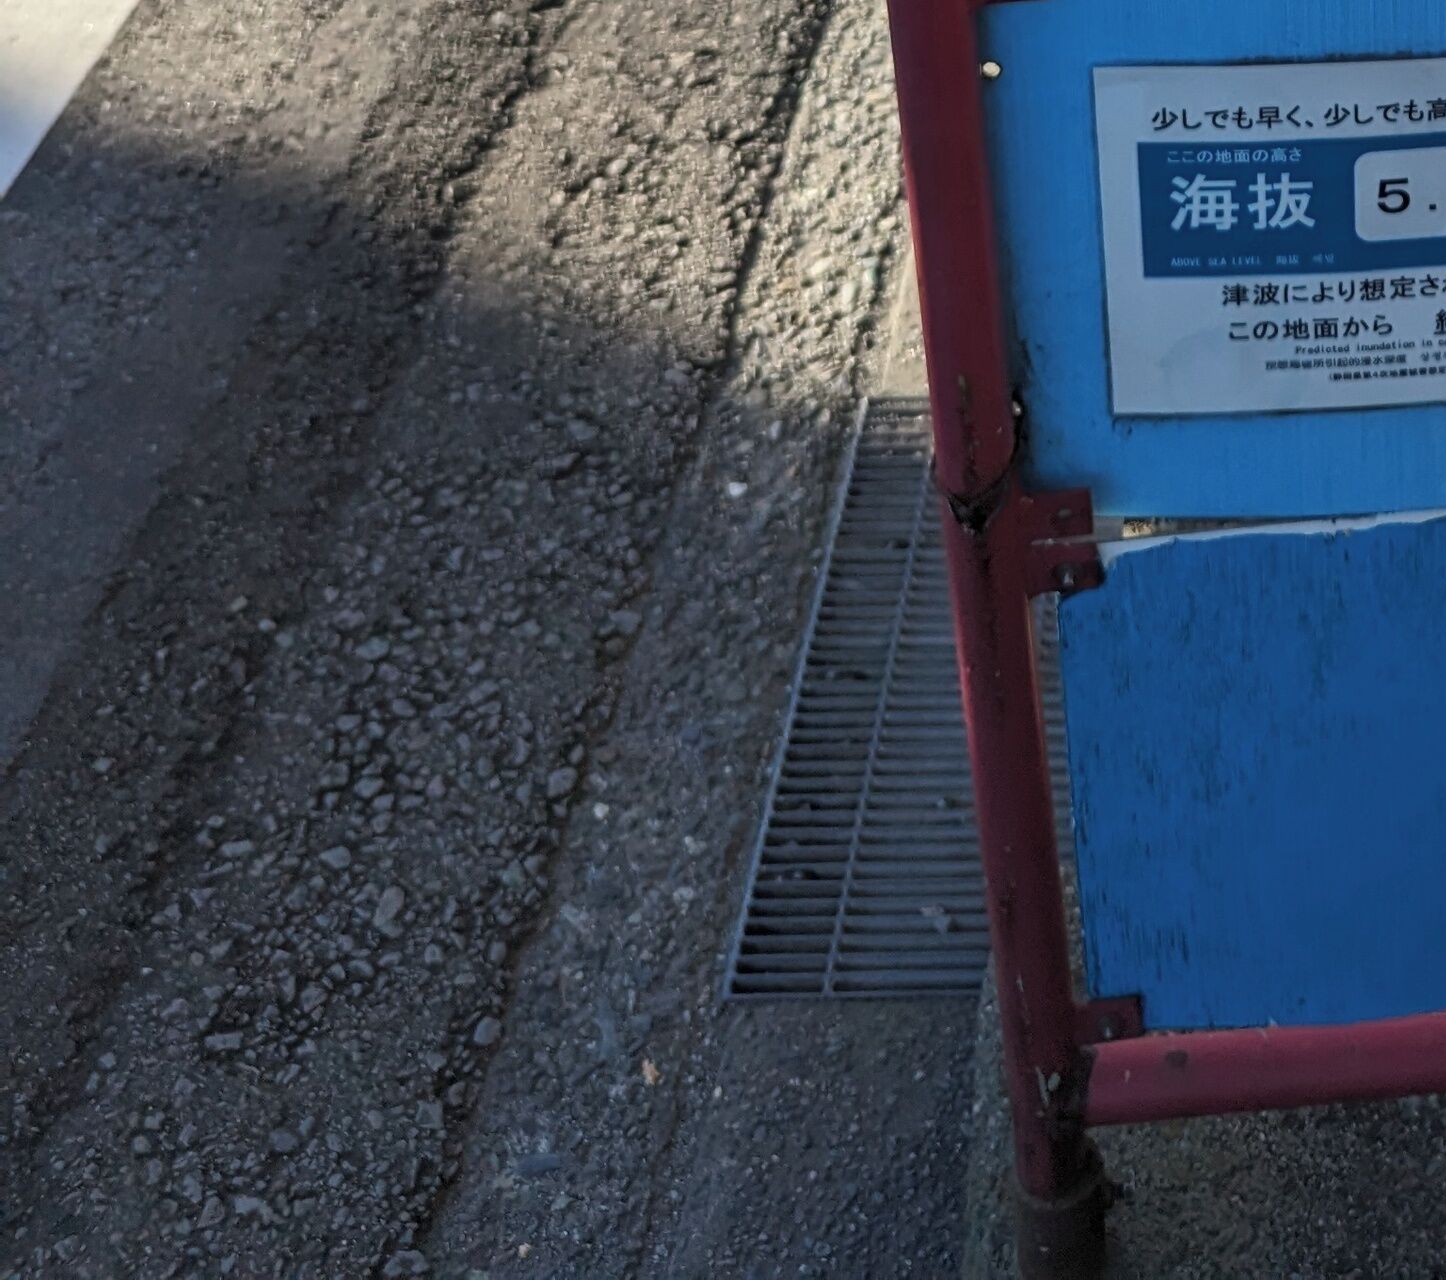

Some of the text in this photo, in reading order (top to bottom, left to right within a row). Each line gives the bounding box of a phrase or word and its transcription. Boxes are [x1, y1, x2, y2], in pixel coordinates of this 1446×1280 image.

[1170, 172, 1315, 232] 海抜
[1229, 312, 1394, 341] この地面から
[1295, 344, 1350, 354] Predicted
